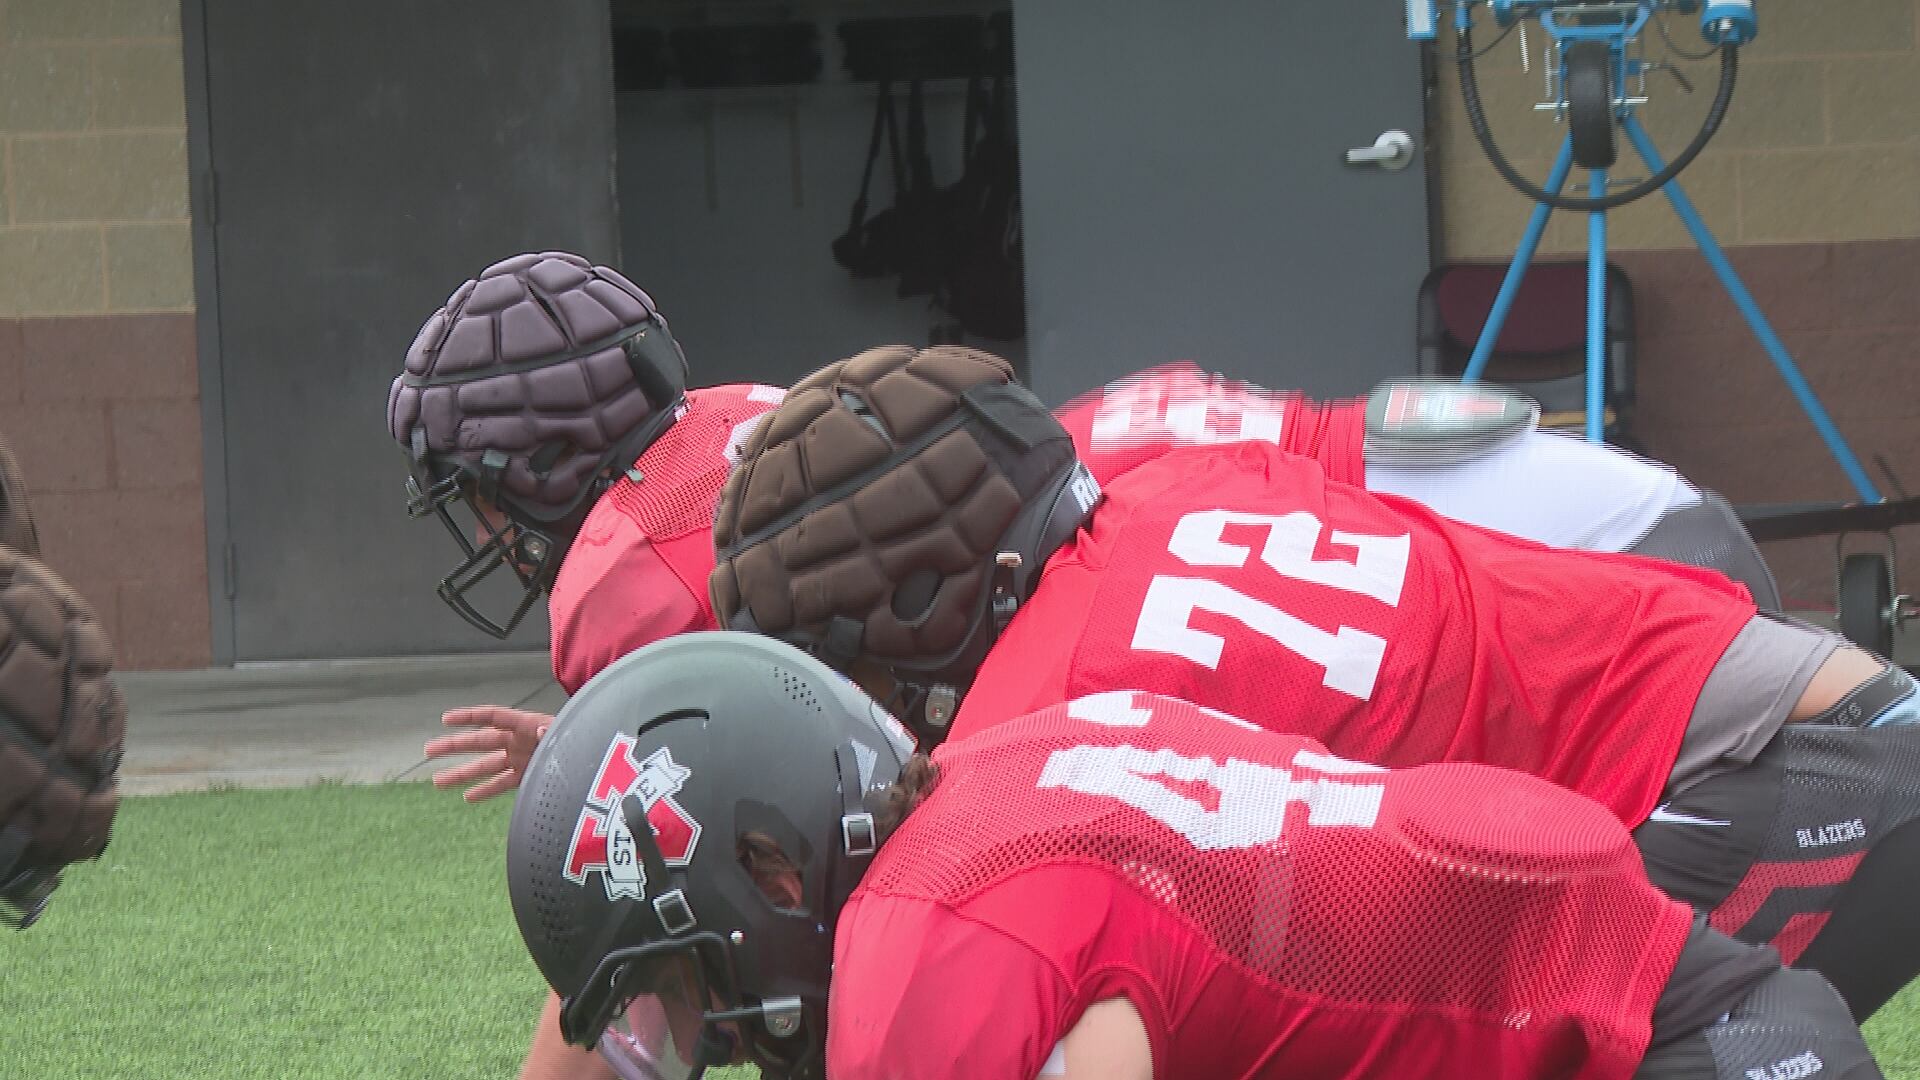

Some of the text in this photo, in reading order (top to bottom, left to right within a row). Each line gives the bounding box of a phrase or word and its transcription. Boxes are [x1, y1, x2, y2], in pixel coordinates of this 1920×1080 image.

[1131, 509, 1411, 701] 72
[612, 777, 659, 867] STE
[1036, 690, 1391, 850] 4
[1796, 818, 1866, 848] BLAZERS
